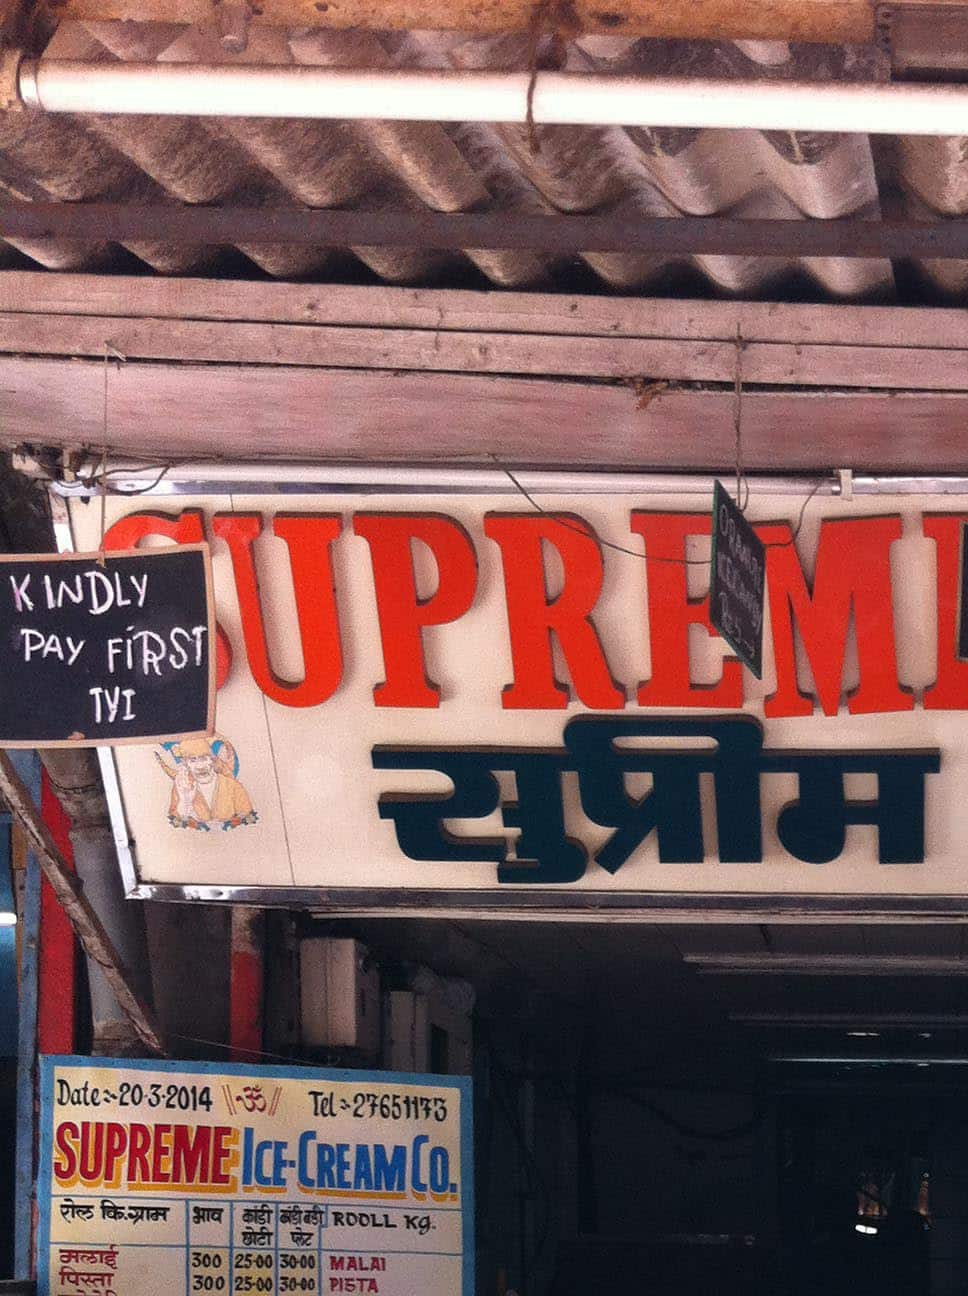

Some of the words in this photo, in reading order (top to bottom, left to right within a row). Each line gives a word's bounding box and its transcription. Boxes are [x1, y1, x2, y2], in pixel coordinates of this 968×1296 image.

[10, 571, 148, 615] KINDLY
[20, 628, 86, 666] PAY
[372, 712, 941, 883] सुप्रीम
[54, 1121, 233, 1186] SUPREME
[332, 1211, 397, 1228] ROOLL
[59, 1245, 119, 1269] मलाई
[192, 1252, 222, 1268] 300
[329, 1256, 386, 1271] MALAI
[59, 1266, 114, 1287] पिस्ता
[193, 1275, 224, 1291] 300
[329, 1278, 378, 1293] PISTA
